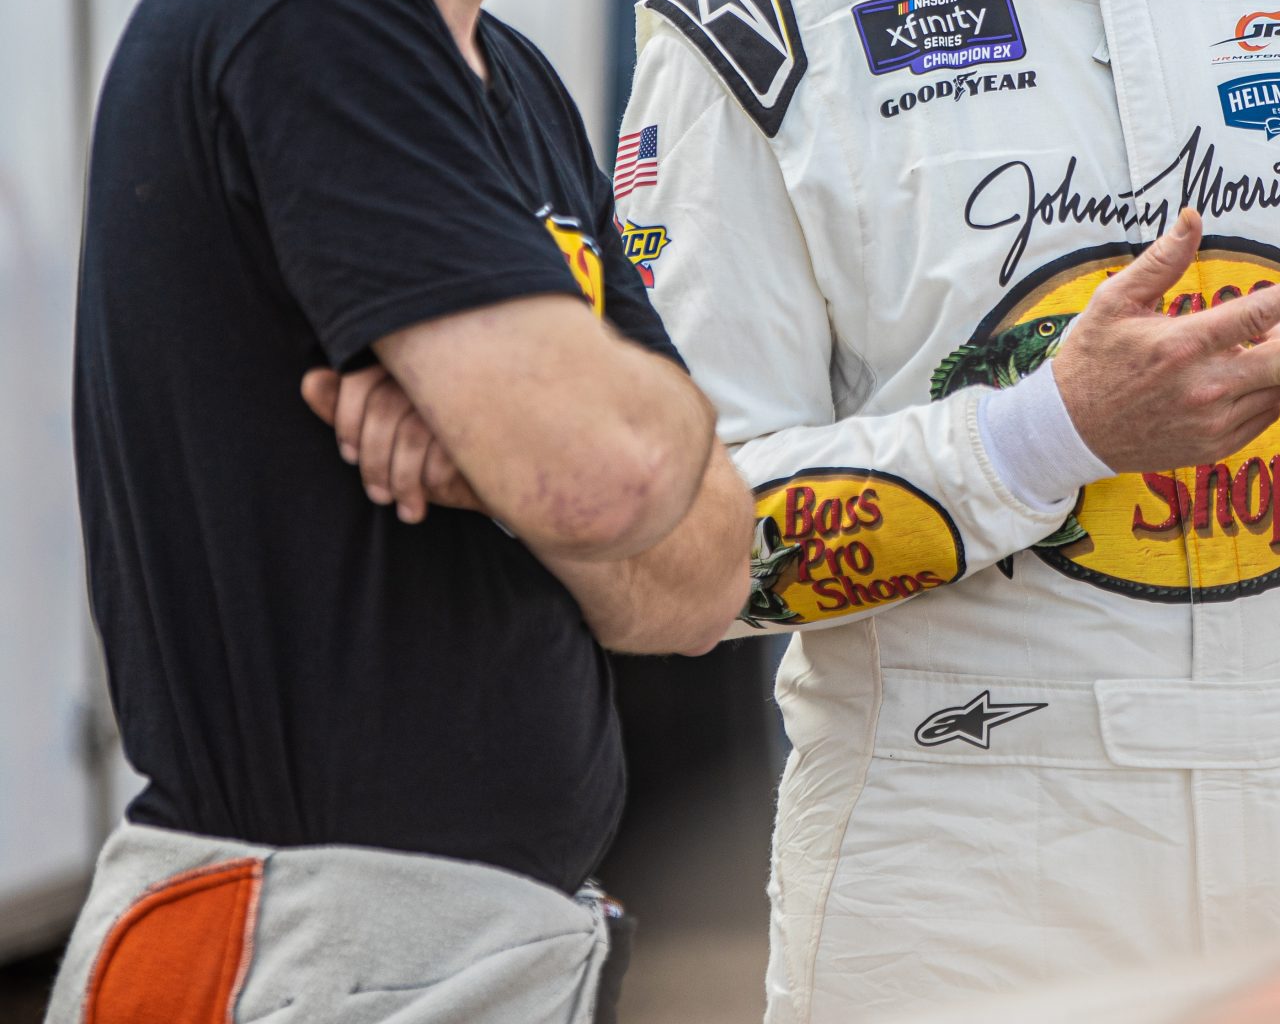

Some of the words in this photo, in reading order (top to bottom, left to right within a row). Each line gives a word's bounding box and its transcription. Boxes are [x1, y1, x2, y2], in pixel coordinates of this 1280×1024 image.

[886, 5, 987, 48] xfinity
[924, 34, 962, 49] SERIES
[923, 47, 991, 68] CHAMPION
[993, 44, 1012, 59] 2X
[880, 71, 1037, 118] GOODYEAR
[964, 156, 1169, 288] Johnny
[783, 486, 882, 539] Bass
[798, 537, 874, 584] Pro
[812, 571, 949, 611] Shops
